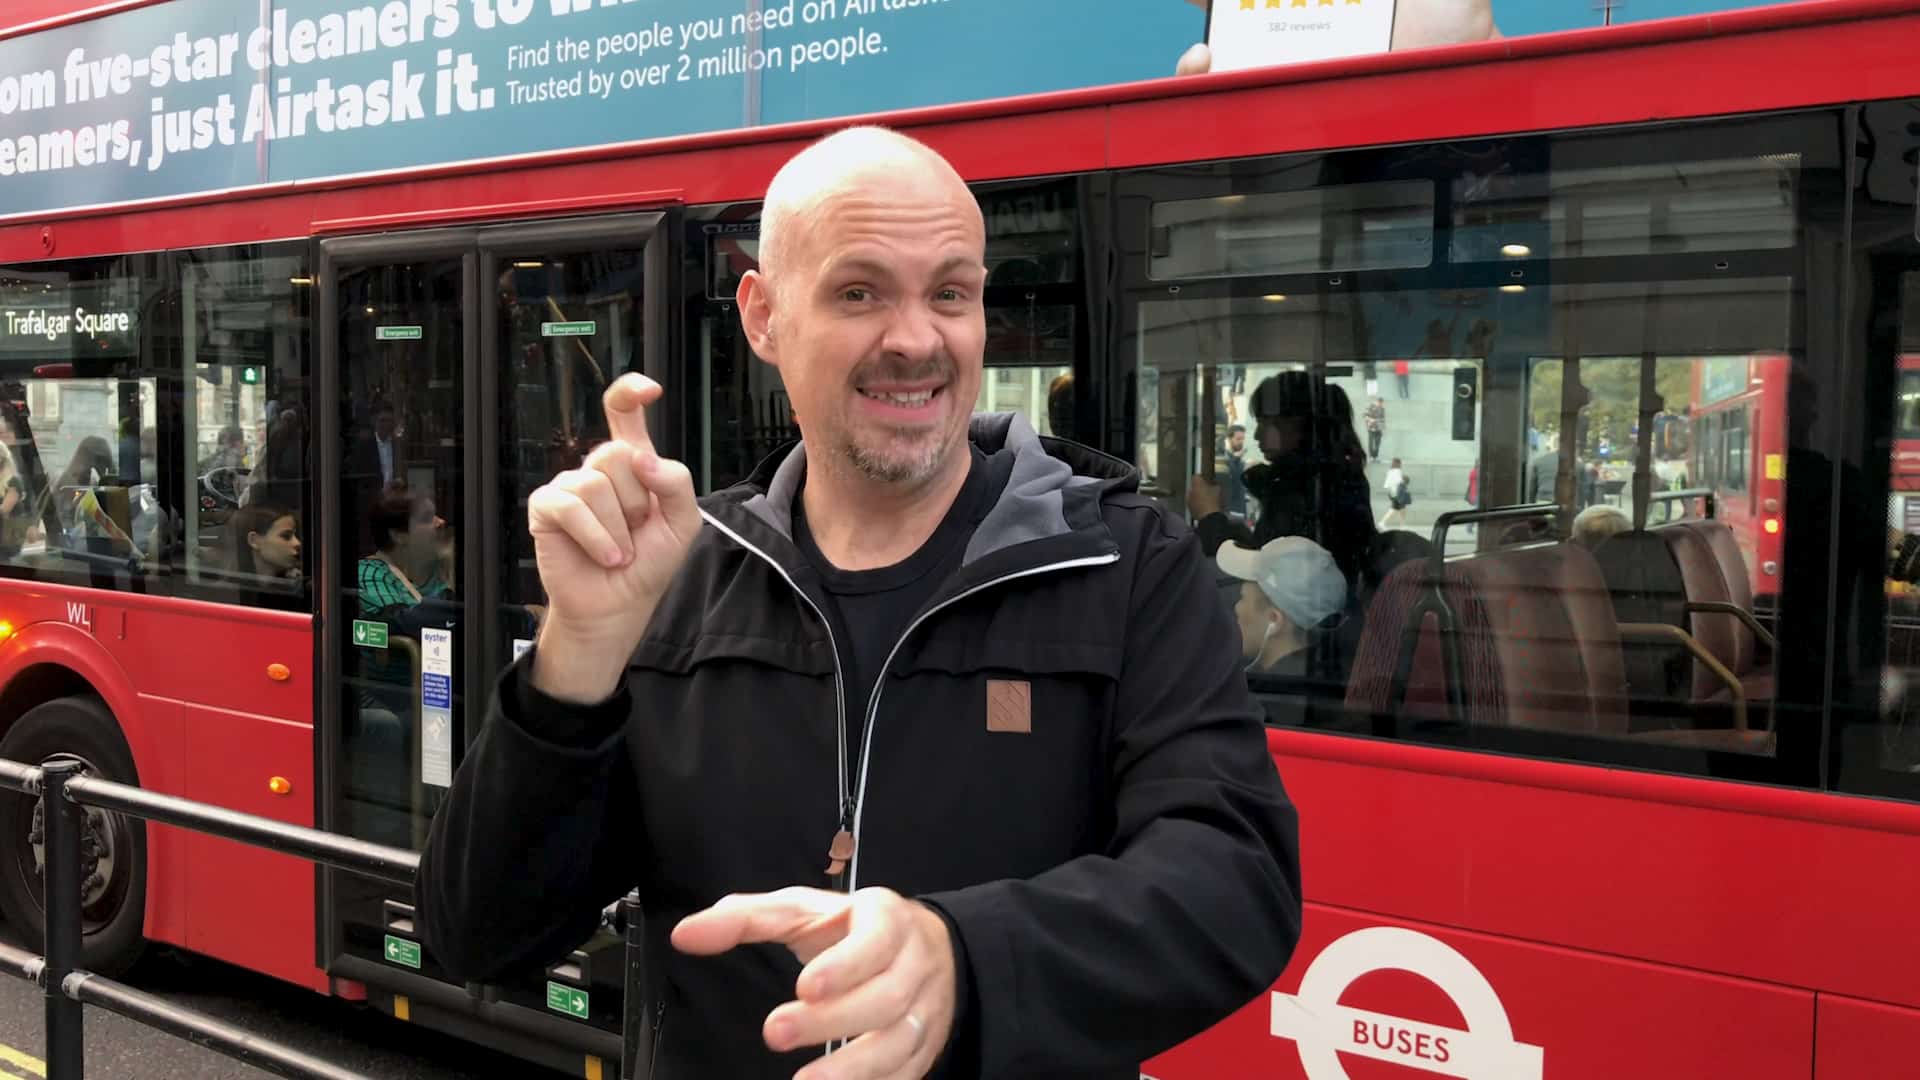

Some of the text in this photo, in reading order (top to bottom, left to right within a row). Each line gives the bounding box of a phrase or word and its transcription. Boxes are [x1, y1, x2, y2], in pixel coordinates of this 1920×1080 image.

[64, 31, 239, 104] five-star
[246, 0, 460, 71] cleaners
[507, 40, 550, 71] Find
[556, 37, 590, 63] the
[596, 21, 673, 63] people
[679, 17, 723, 50] you
[731, 4, 794, 35] need
[802, 0, 836, 24] on
[1290, 22, 1331, 31] reviews
[506, 27, 888, 104] Trusted by over 2 million people.
[147, 94, 236, 172] just
[242, 59, 426, 143] Airtask
[436, 48, 495, 116] it.
[5, 307, 129, 340] Trafalgar Square
[1353, 1019, 1450, 1063] BUSES
